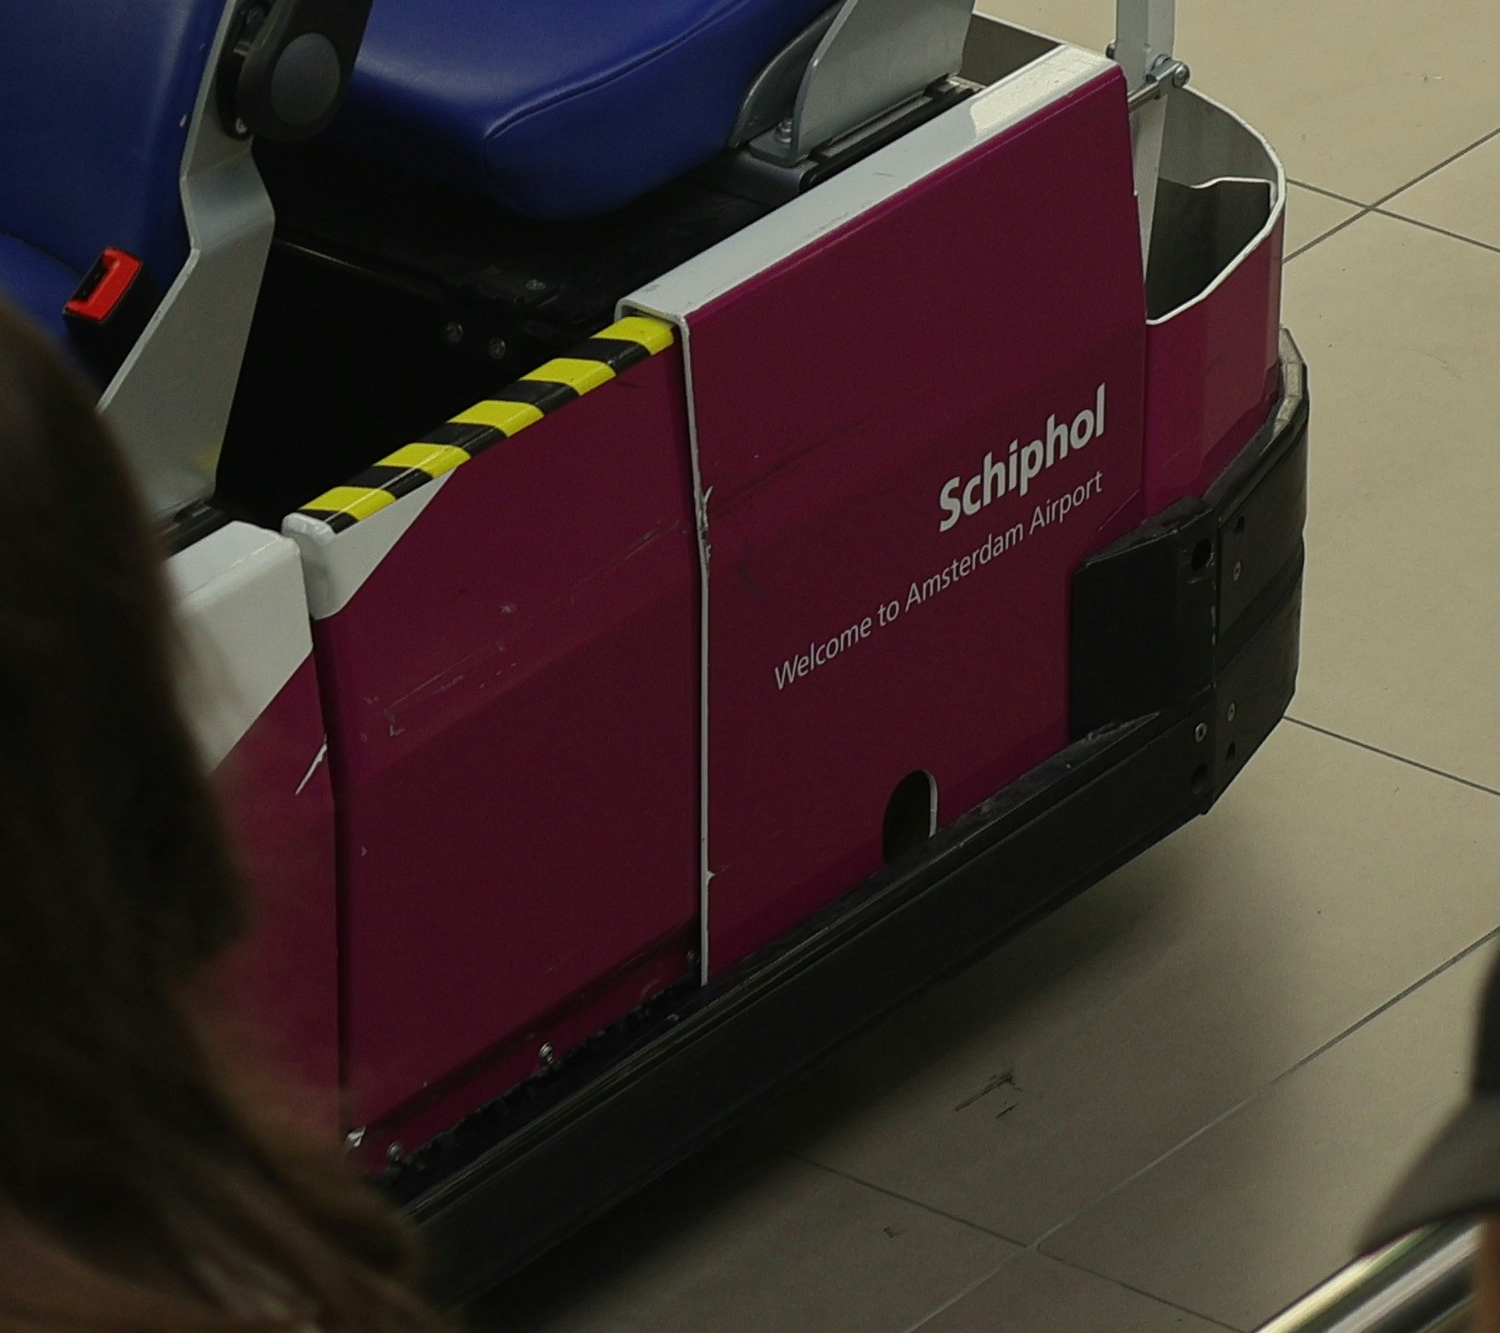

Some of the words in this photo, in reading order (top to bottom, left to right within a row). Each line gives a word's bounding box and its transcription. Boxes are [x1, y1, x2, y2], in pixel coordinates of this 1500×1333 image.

[939, 382, 1106, 533] Schiphol
[774, 617, 872, 690] Welcome
[877, 600, 900, 627] to
[905, 523, 1024, 613] Amsterdam
[1029, 470, 1103, 535] Airport
